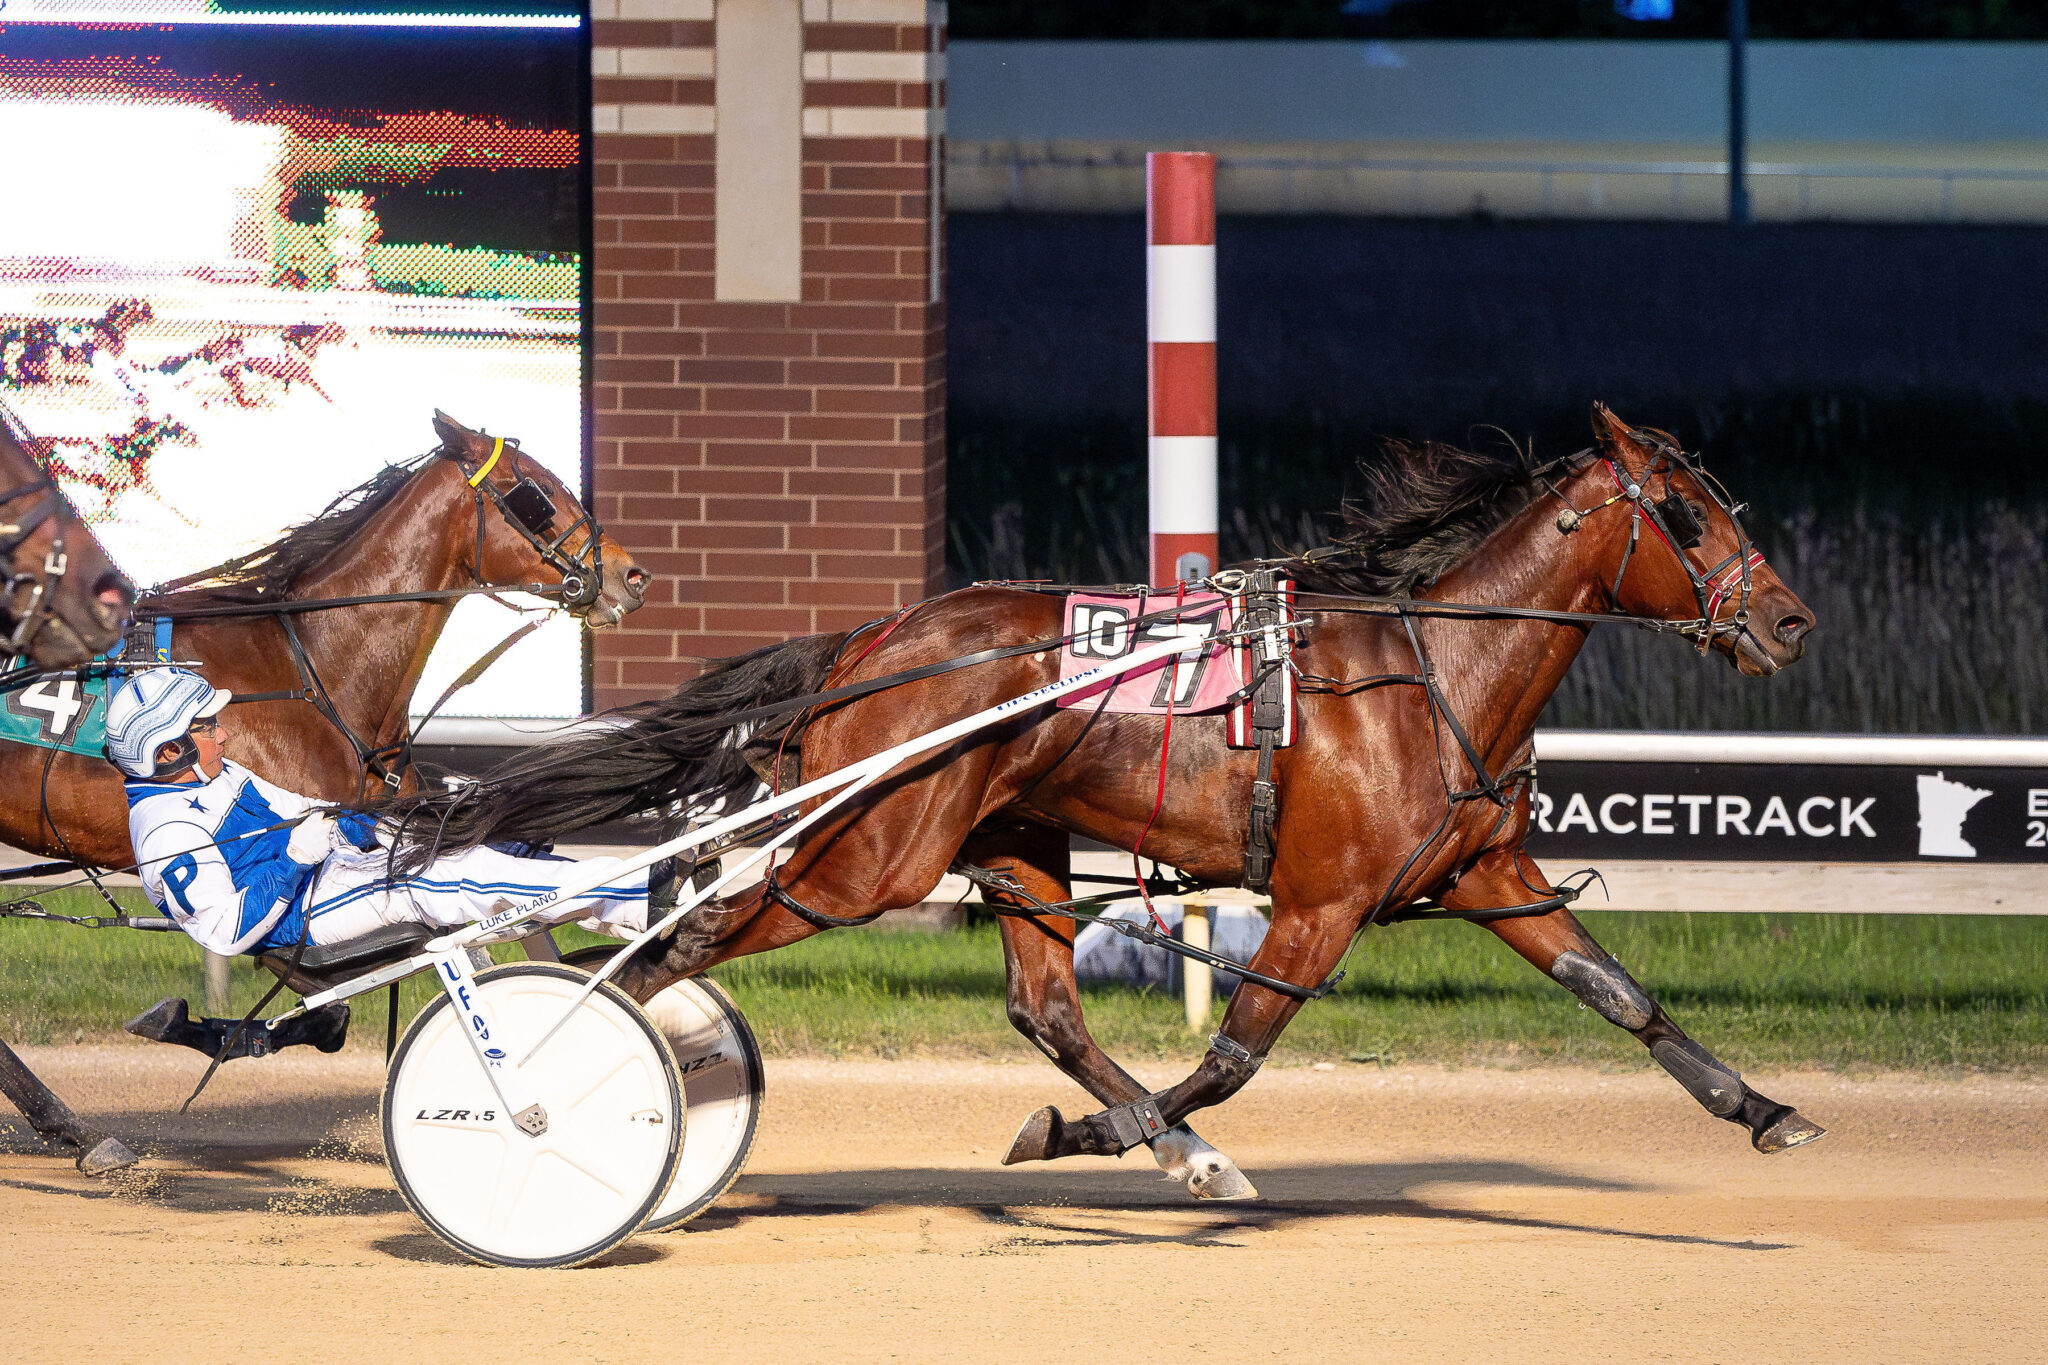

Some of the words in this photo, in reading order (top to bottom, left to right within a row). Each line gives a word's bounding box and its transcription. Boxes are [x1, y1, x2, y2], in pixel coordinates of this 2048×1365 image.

[1072, 606, 1127, 655] 10
[1146, 620, 1213, 702] 7
[19, 680, 82, 735] 4
[1530, 792, 1877, 838] RACETRACK
[2025, 821, 2048, 847] 2
[161, 852, 198, 916] P
[480, 911, 513, 931] LUKE
[516, 891, 558, 915] PLANO
[442, 958, 490, 1041] UFO
